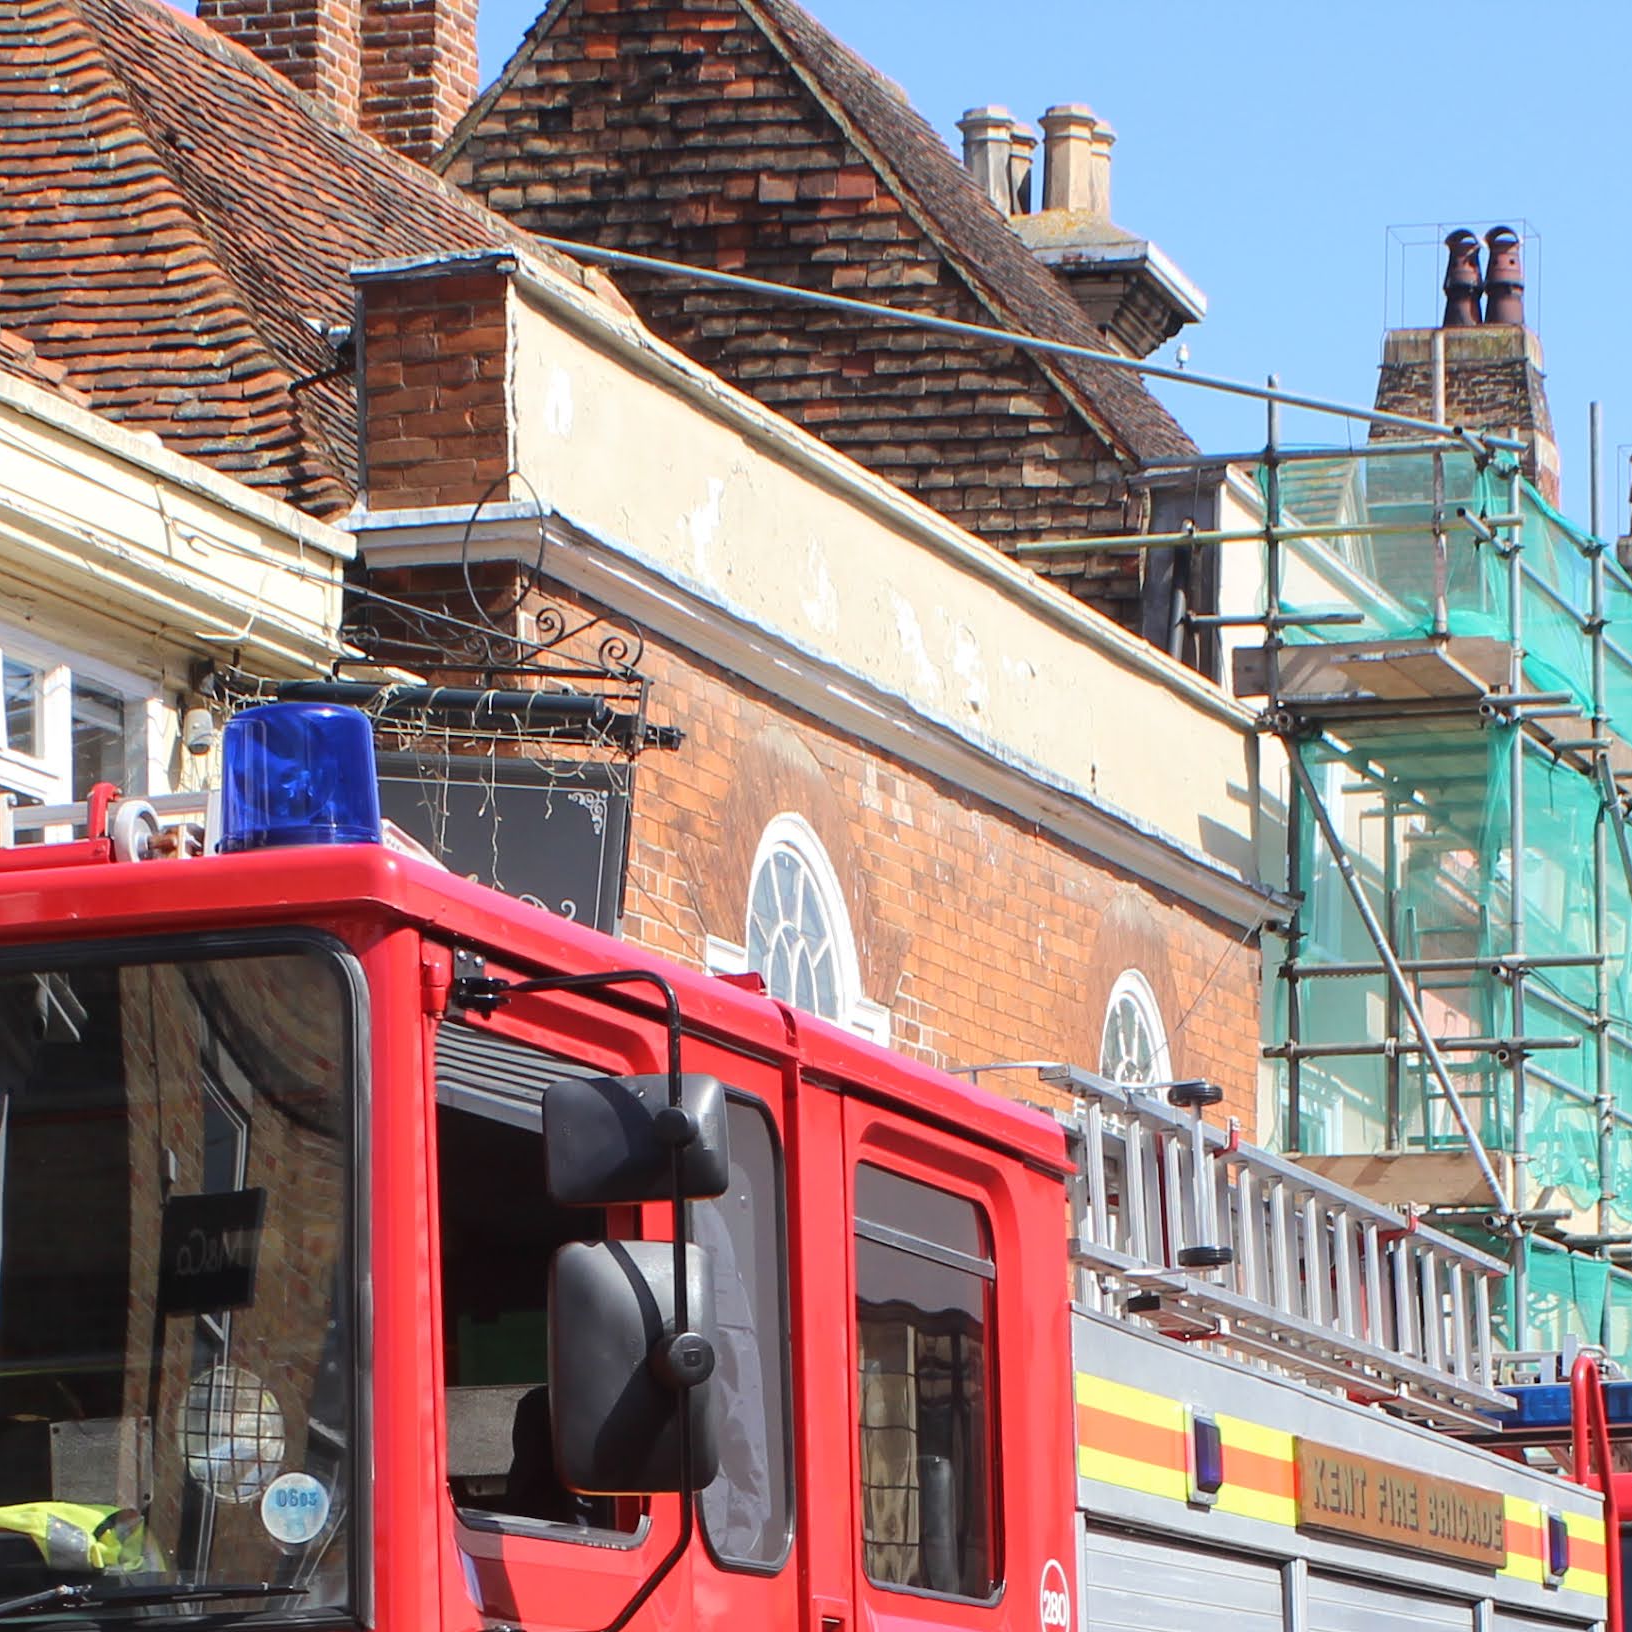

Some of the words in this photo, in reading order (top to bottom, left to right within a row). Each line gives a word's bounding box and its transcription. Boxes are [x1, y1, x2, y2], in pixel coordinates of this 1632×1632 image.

[1312, 1455, 1367, 1519] KENT
[1375, 1475, 1419, 1532] FIRE
[1427, 1487, 1504, 1552] BRIGADE
[1043, 1589, 1066, 1627] 280
